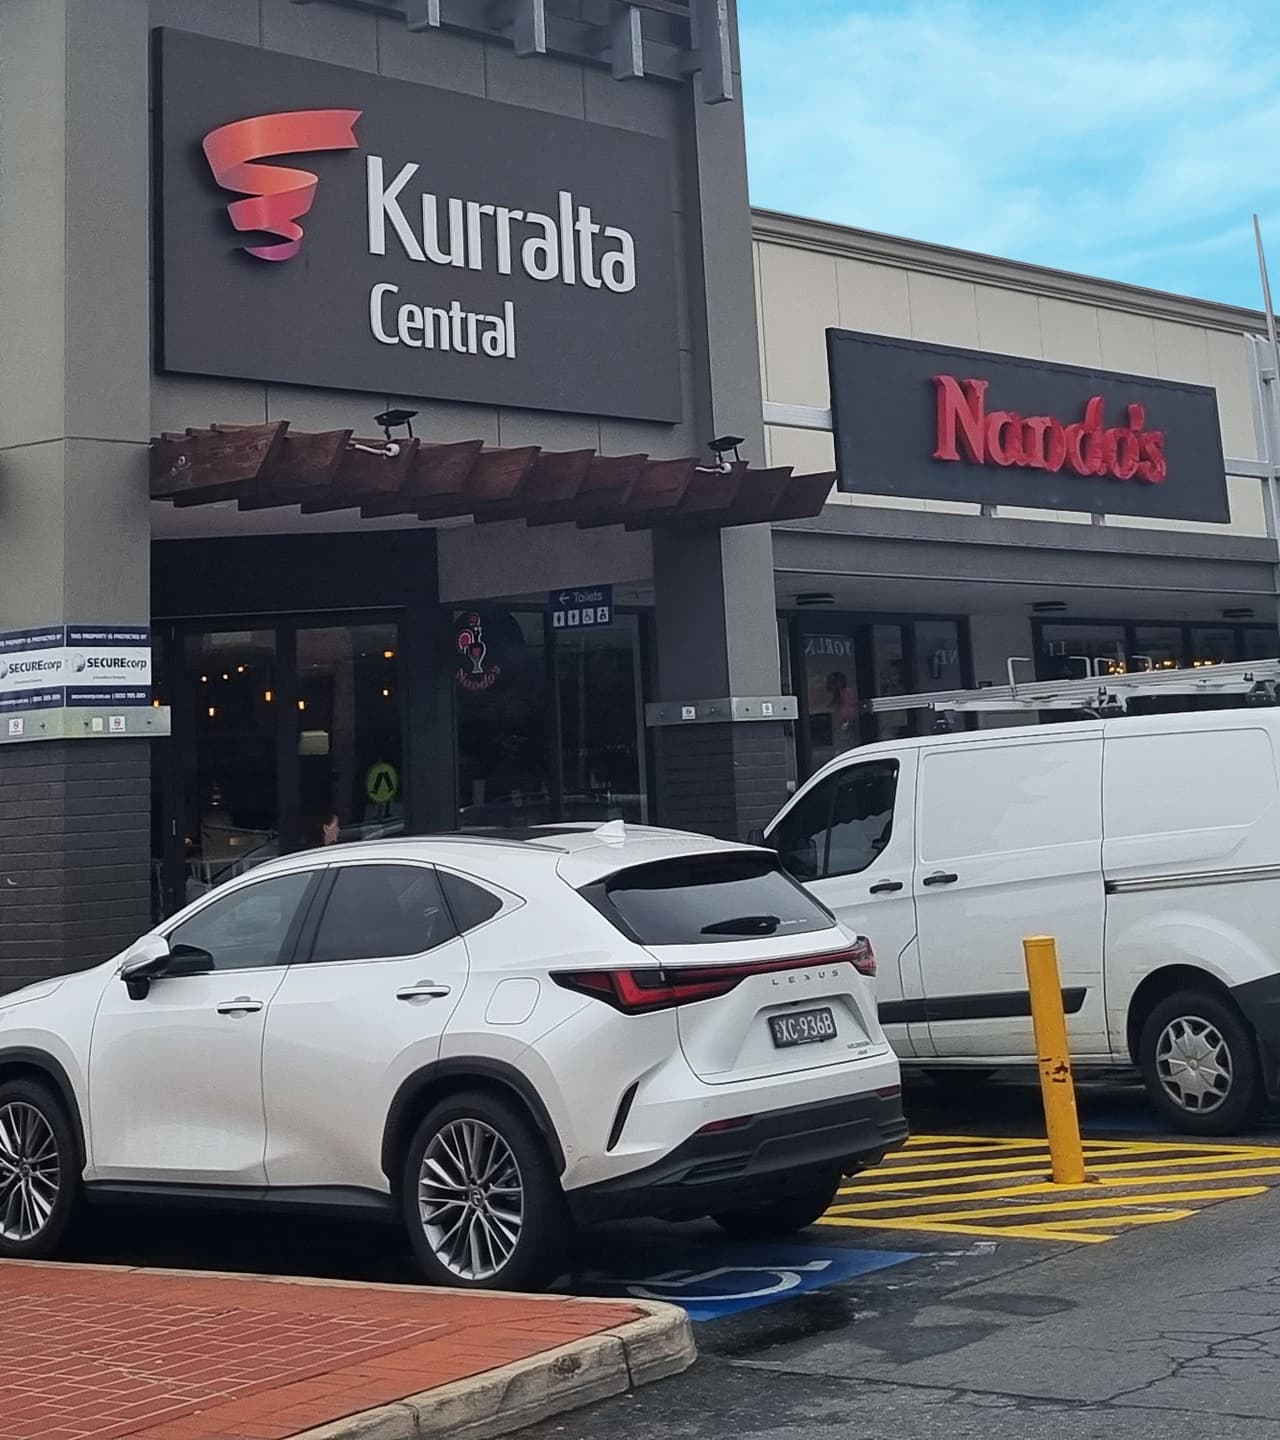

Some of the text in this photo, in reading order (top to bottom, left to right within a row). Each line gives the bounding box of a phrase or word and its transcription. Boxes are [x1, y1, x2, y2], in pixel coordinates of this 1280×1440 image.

[366, 154, 636, 294] Kurralta
[370, 282, 516, 359] Central
[932, 374, 1167, 484] Nando's
[573, 592, 603, 603] Toilets
[8, 660, 62, 675] SECUREcorp
[86, 657, 147, 671] SECUREcorp
[771, 969, 839, 986] LEXUS
